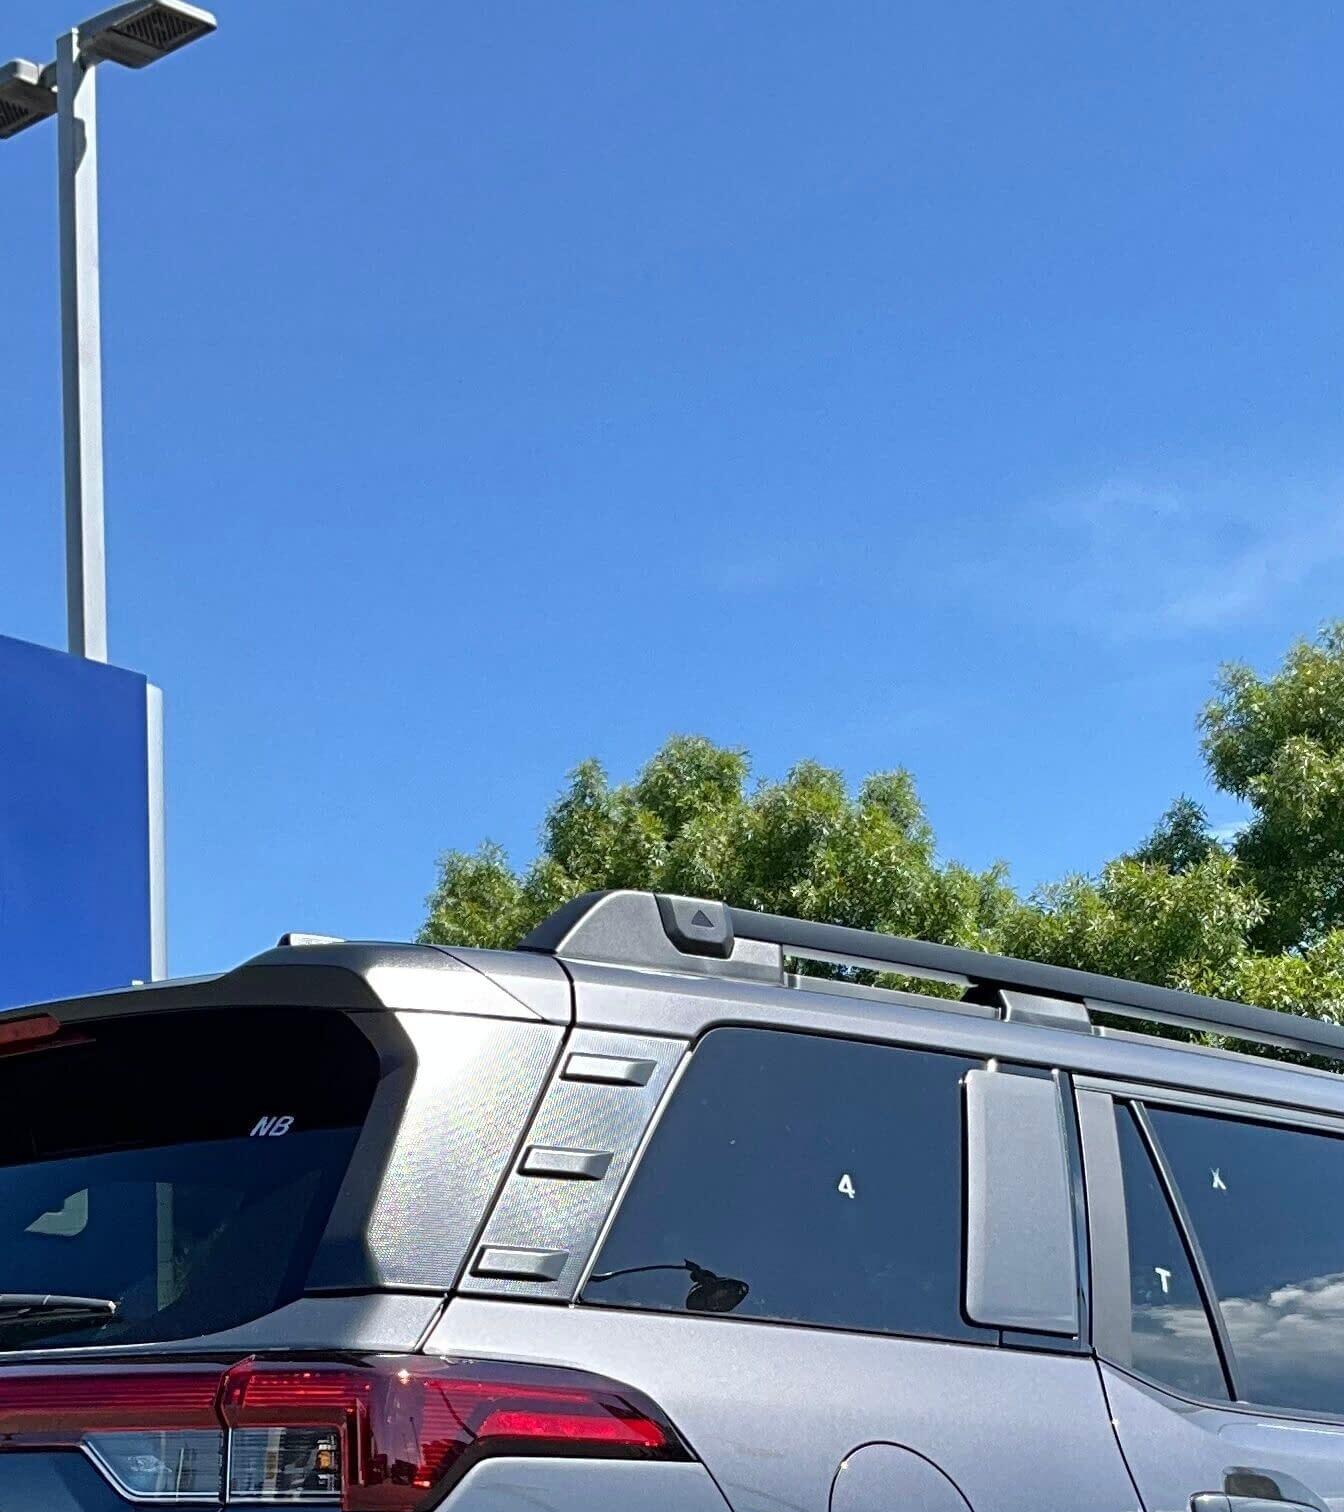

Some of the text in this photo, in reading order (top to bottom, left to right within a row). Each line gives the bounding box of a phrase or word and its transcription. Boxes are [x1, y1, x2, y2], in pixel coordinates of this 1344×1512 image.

[249, 1115, 295, 1137] NB
[838, 1174, 856, 1199] 4
[1155, 1267, 1171, 1293] T
